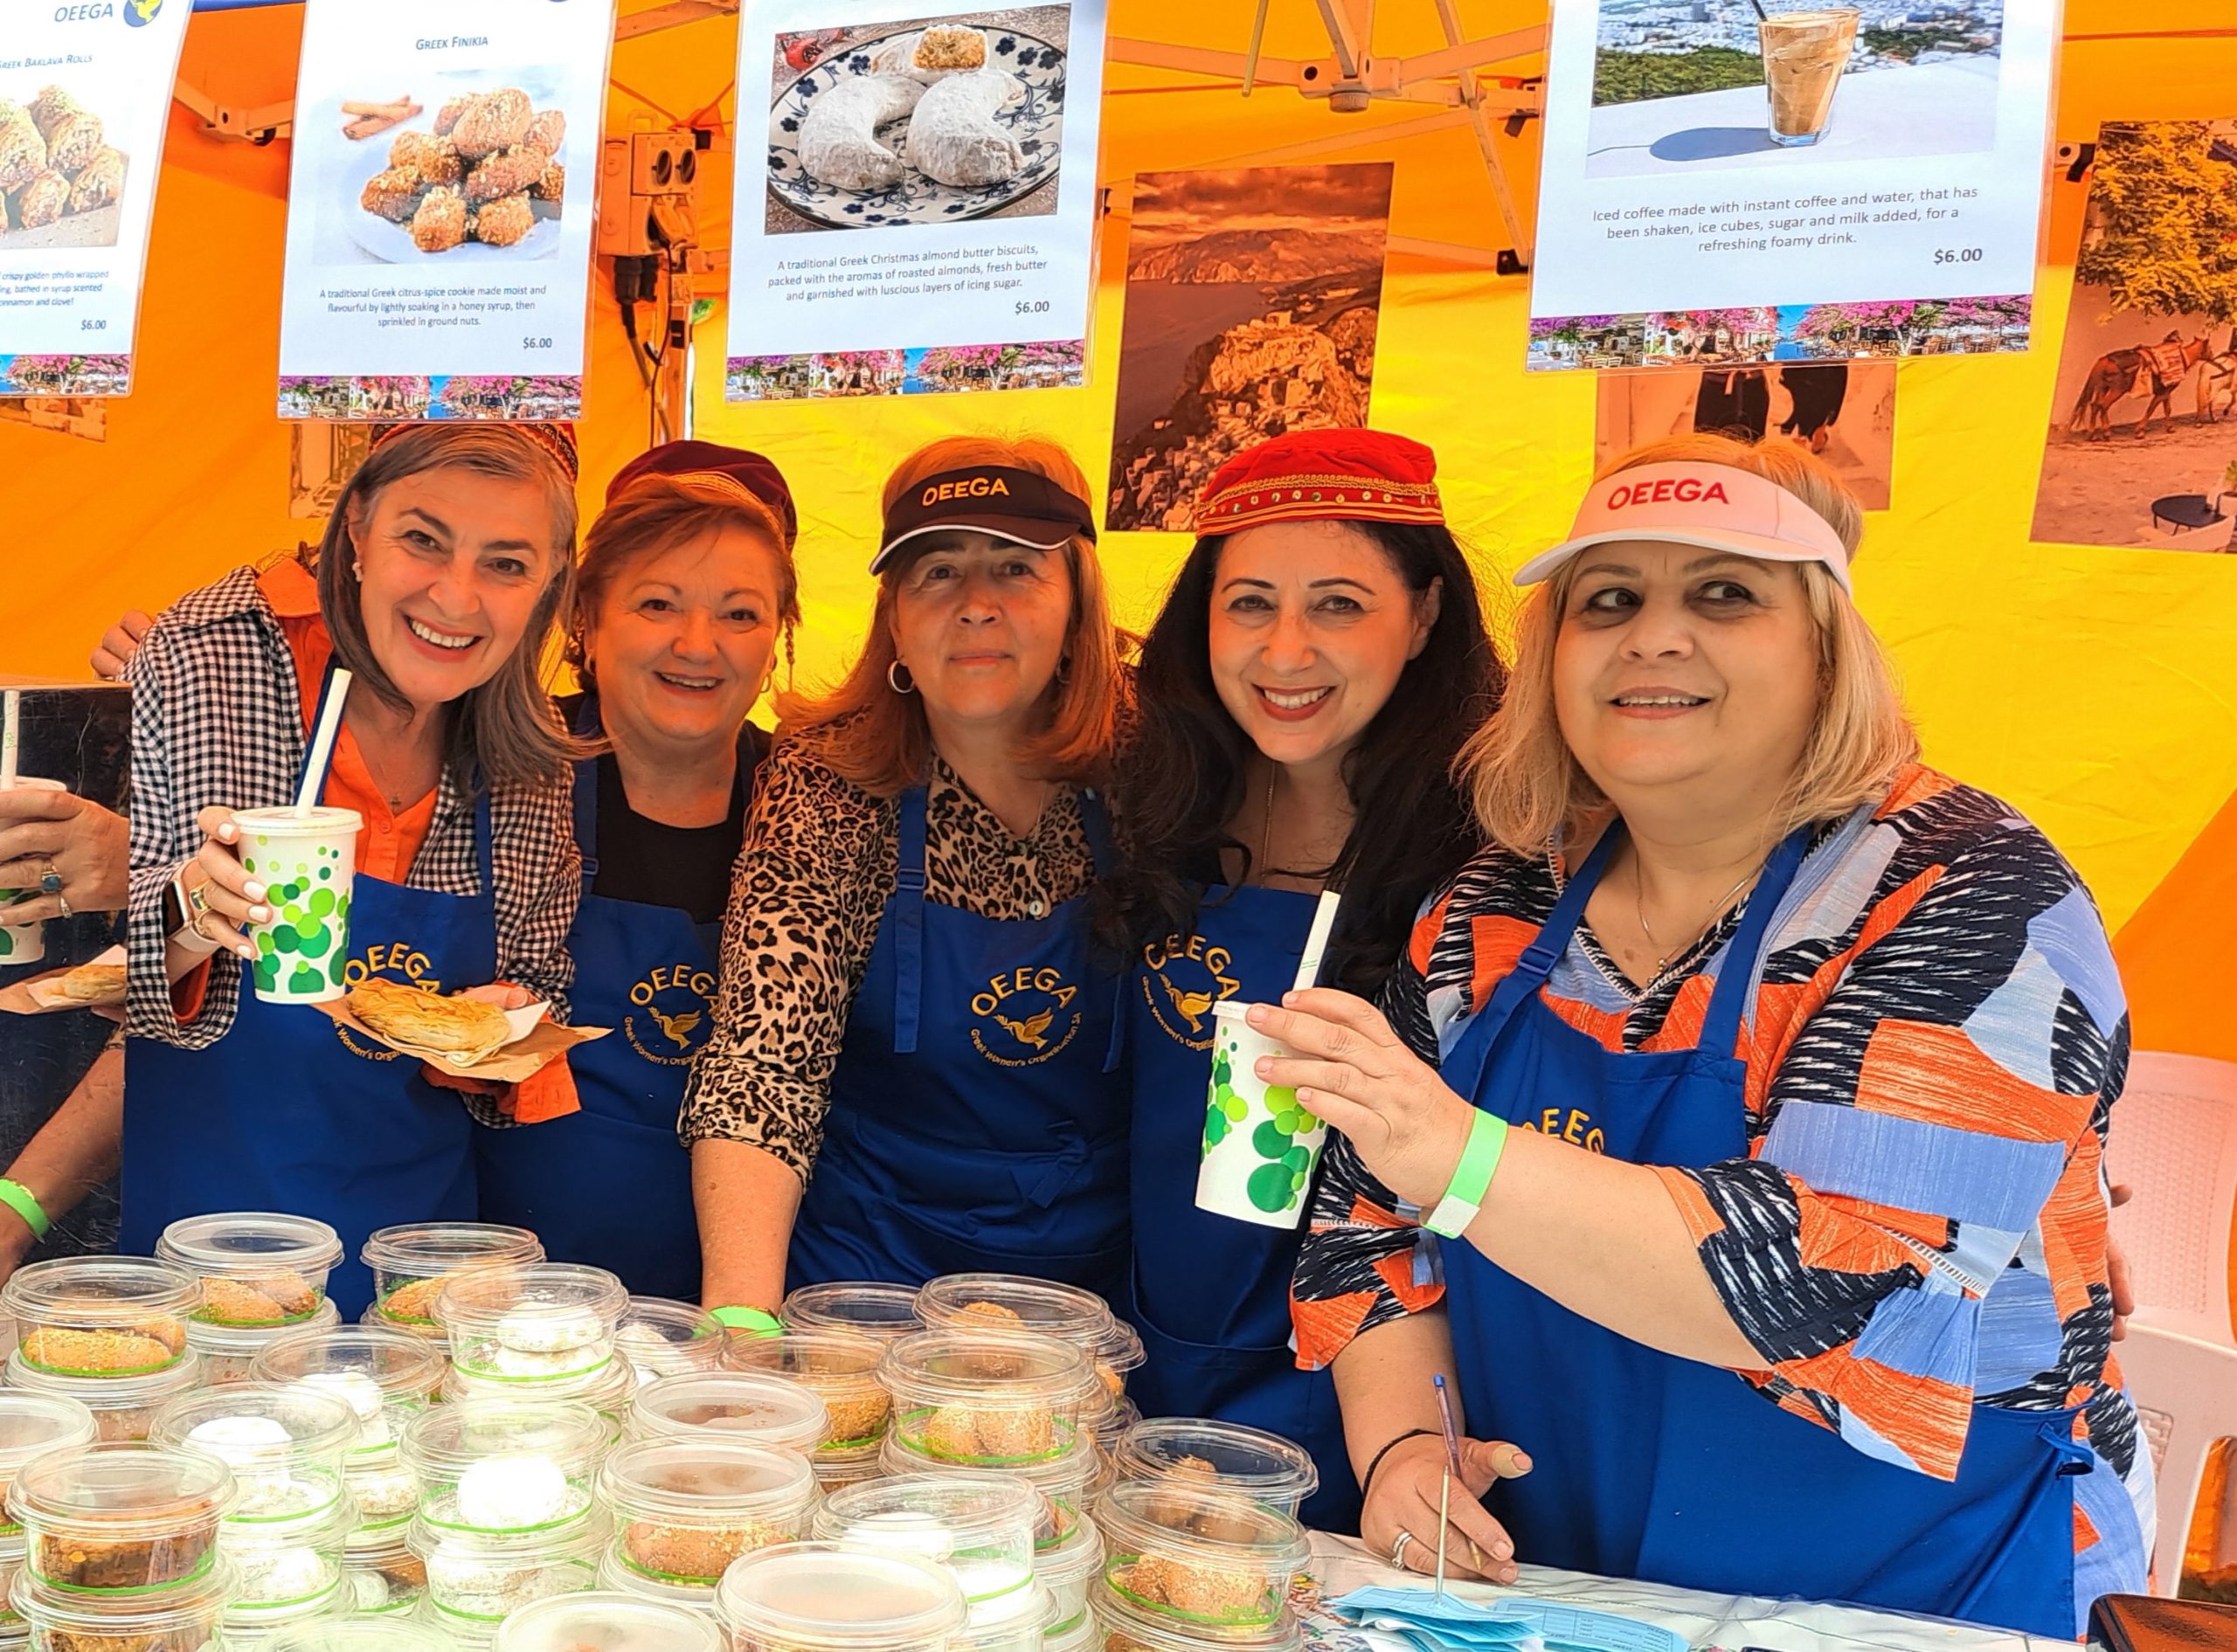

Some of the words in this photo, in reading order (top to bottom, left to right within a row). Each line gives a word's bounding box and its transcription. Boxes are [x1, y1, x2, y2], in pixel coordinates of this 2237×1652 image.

[54, 3, 113, 23] OEEGA
[416, 38, 448, 51] GREEK
[452, 36, 488, 48] FINIKIA
[0, 60, 22, 69] REEK
[1593, 208, 1621, 222] Iced
[1624, 205, 1665, 220] coffee
[1668, 202, 1707, 218] made
[1709, 200, 1740, 215] with
[1743, 198, 1791, 213] instant
[1793, 194, 1838, 210] coffee
[1840, 191, 1868, 206] and
[1871, 191, 1915, 204] water,
[1920, 187, 1950, 202] that
[1953, 185, 1978, 199] has
[1606, 226, 1640, 240] been
[1644, 223, 1693, 238] shaken,
[1698, 221, 1717, 234] ice
[1721, 218, 1764, 233] cubes,
[1768, 218, 1806, 232] sugar
[1809, 212, 1836, 227] and
[1839, 211, 1869, 225] milk
[1873, 207, 1922, 224] added,
[1926, 207, 1948, 220] for
[1950, 208, 1959, 218] a
[1698, 237, 1768, 252] refreshing
[1770, 234, 1814, 249] foamy
[1817, 230, 1857, 246] drink.
[777, 259, 786, 271] A
[786, 255, 837, 271] traditional
[839, 253, 869, 267] Greek
[870, 252, 920, 266] Christmas
[921, 247, 960, 263] almond
[962, 247, 995, 259] butter
[996, 244, 1039, 257] biscuits,
[1934, 248, 1983, 265] $6.00
[24, 271, 50, 281] golden
[76, 270, 109, 280] wrapped
[767, 273, 802, 289] packed
[803, 273, 826, 285] with
[828, 272, 845, 284] the
[846, 271, 883, 283] aromas
[884, 267, 897, 280] of
[897, 265, 936, 280] roasted
[937, 262, 984, 277] almonds,
[986, 259, 1013, 273] fresh
[1015, 259, 1049, 273] butter
[15, 285, 40, 294] bathed
[73, 284, 103, 293] scented
[319, 288, 327, 299] A
[327, 287, 371, 299] traditional
[371, 287, 397, 298] Greek
[398, 287, 447, 299] citrus-spice
[447, 286, 476, 297] cookie
[477, 285, 502, 296] made
[502, 285, 529, 296] moist
[529, 284, 547, 295] and
[786, 289, 805, 301] and
[806, 286, 855, 303] garnished
[855, 285, 878, 298] with
[880, 283, 921, 296] luscious
[922, 281, 952, 295] layers
[953, 279, 966, 292] of
[966, 279, 991, 293] icing
[993, 278, 1023, 292] sugar.
[36, 297, 50, 306] and
[327, 301, 368, 314] flavourful
[368, 302, 379, 315] by
[380, 301, 407, 315] lightly
[407, 301, 440, 315] soaking
[440, 301, 450, 312] in
[451, 302, 457, 312] a
[459, 301, 486, 314] honey
[487, 302, 514, 314] syrup,
[515, 299, 536, 310] then
[1015, 301, 1049, 315] $6.00
[80, 319, 107, 330] $6.00
[377, 315, 417, 329] sprinkled
[418, 315, 426, 327] in
[426, 315, 459, 329] ground
[459, 316, 481, 326] nuts.
[523, 336, 552, 349] $6.00
[922, 477, 1010, 507] OEEGA
[1607, 478, 1729, 510] OEEGA
[344, 942, 440, 994] OEEGA
[971, 967, 1077, 1016] OEEGA
[336, 1027, 374, 1060] Women's
[632, 1040, 668, 1065] Women's
[970, 1028, 988, 1054] Greek
[985, 1051, 1026, 1067] Women's
[1521, 1108, 1605, 1155] EEG
